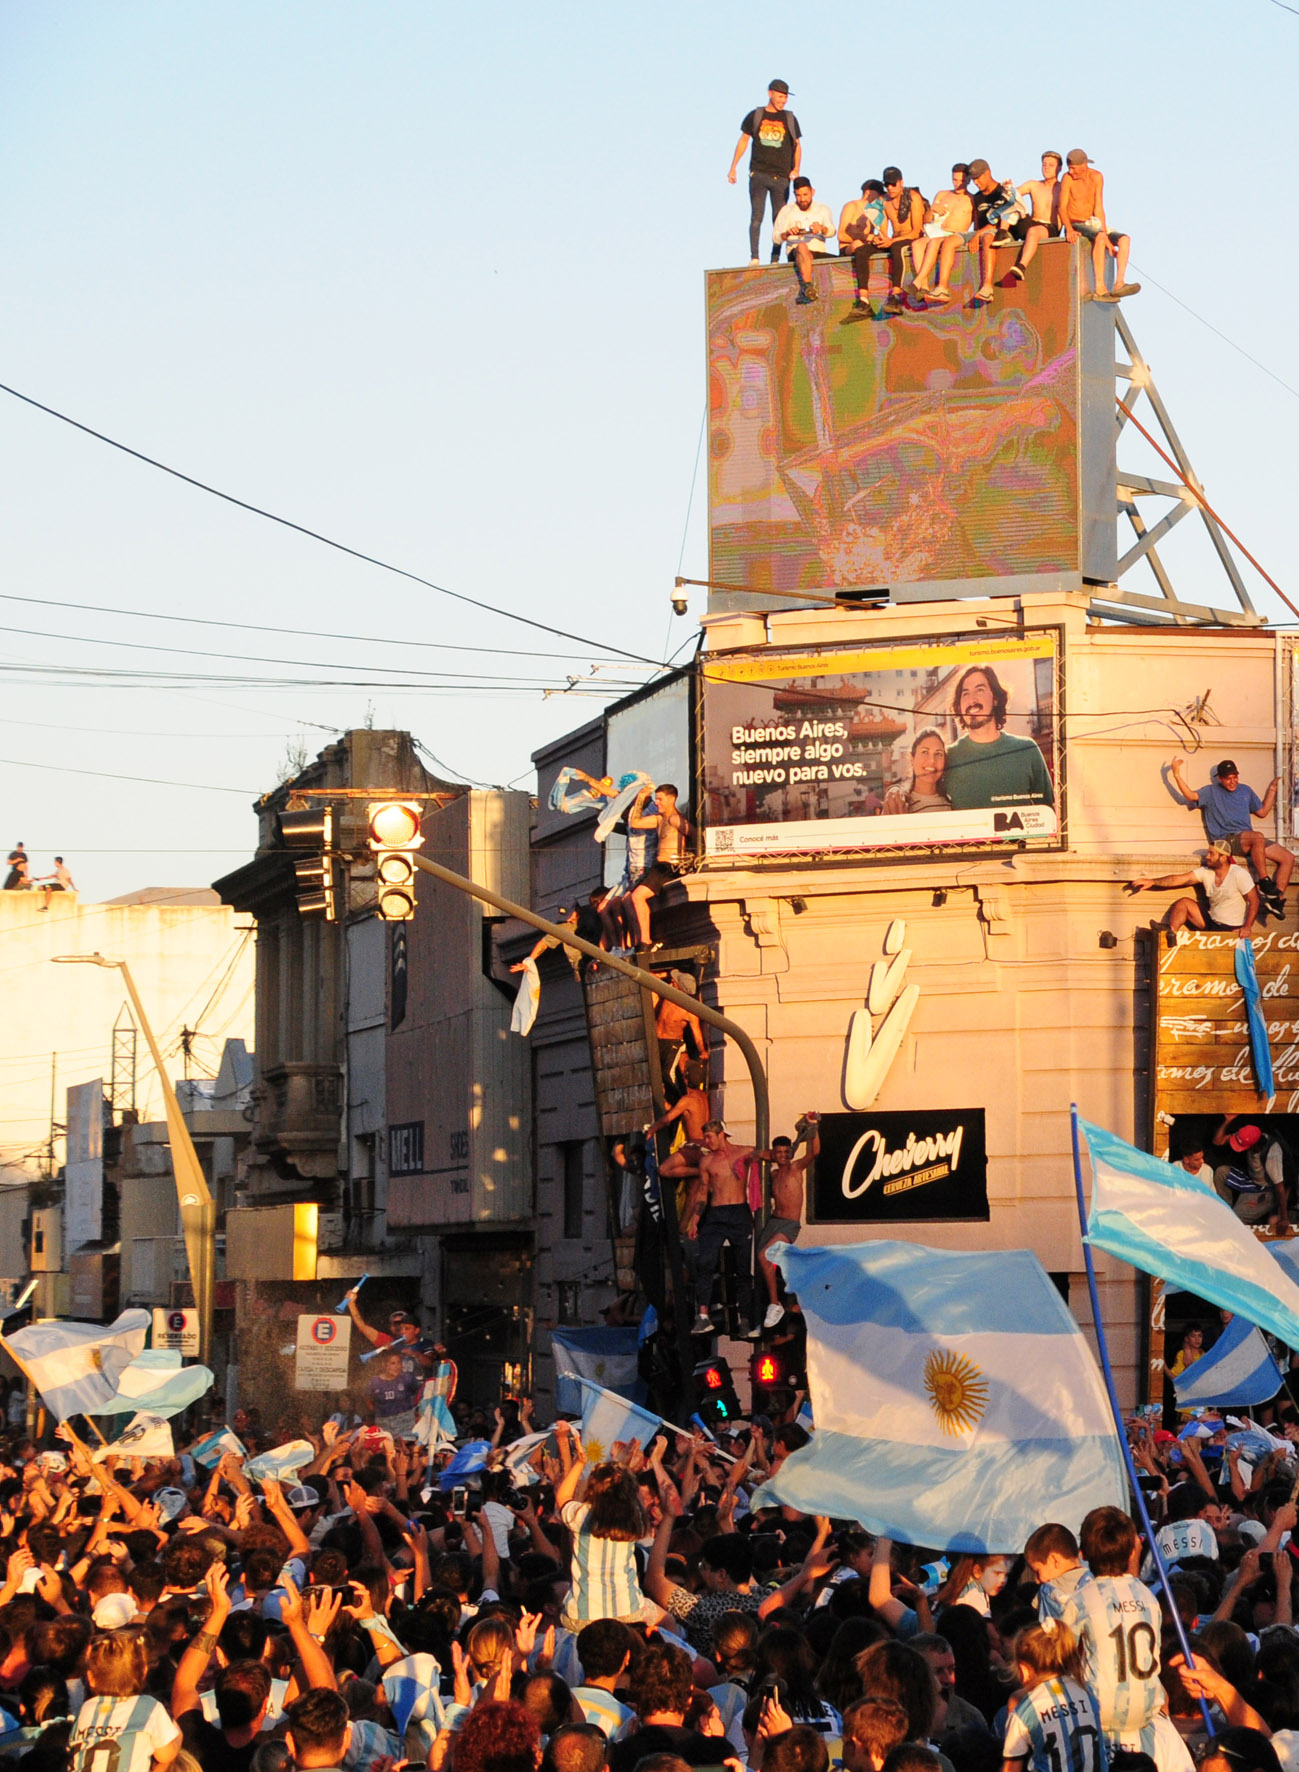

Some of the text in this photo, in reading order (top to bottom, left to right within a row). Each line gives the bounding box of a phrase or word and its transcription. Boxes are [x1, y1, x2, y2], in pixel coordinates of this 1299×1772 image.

[731, 719, 849, 744] Buenos Aires,
[731, 740, 844, 765] siempre algo
[732, 762, 868, 786] nuevo para vos.
[740, 834, 764, 843] Conocé
[317, 1323, 330, 1339] E
[1112, 1600, 1147, 1613] MESSI
[1108, 1621, 1158, 1683] 10
[1040, 1700, 1088, 1724] MESSI
